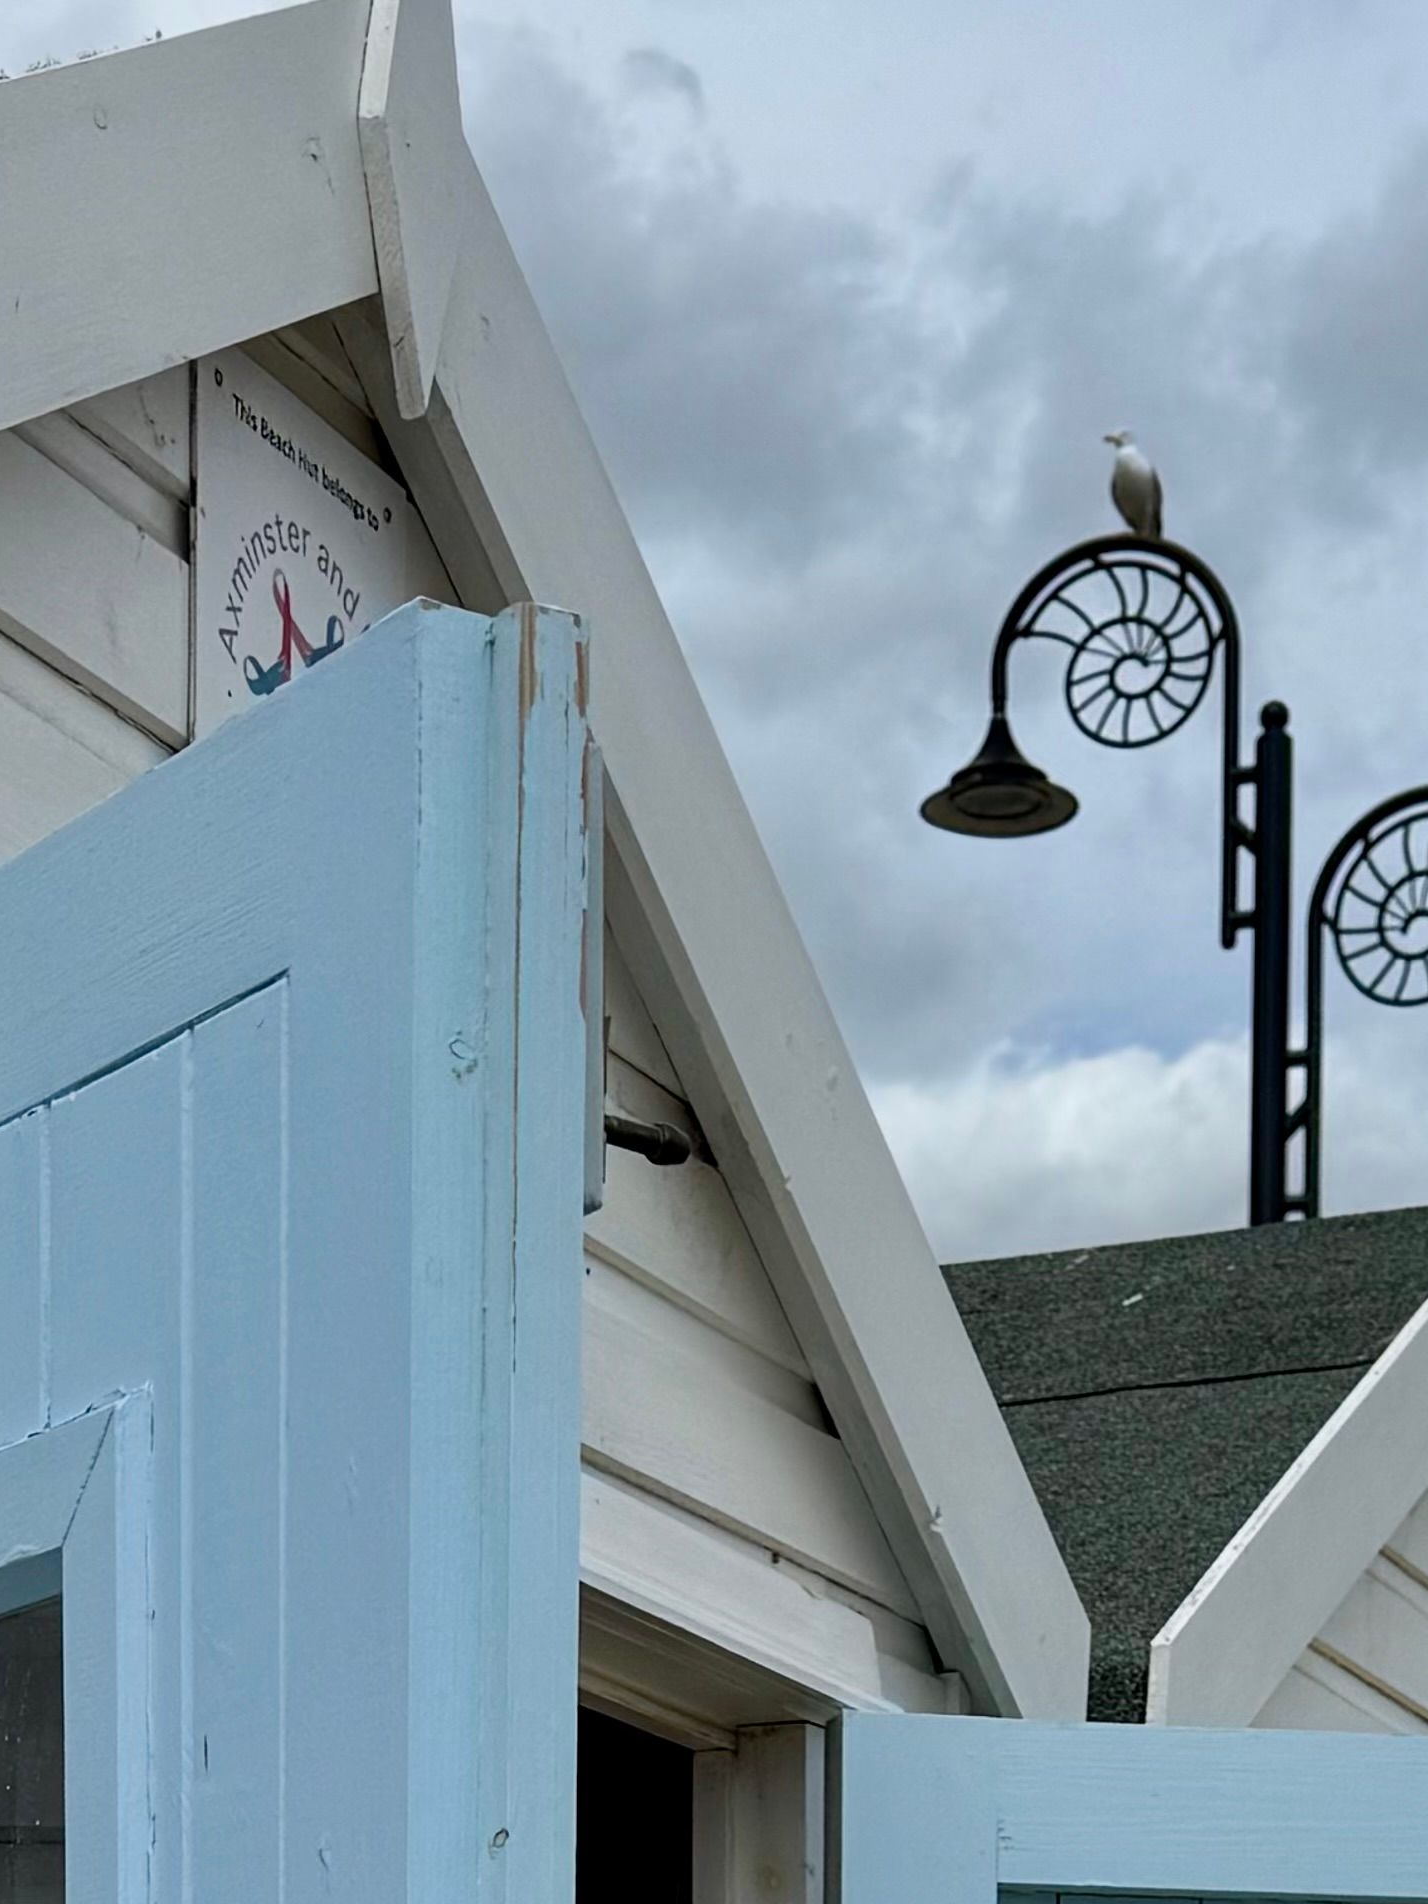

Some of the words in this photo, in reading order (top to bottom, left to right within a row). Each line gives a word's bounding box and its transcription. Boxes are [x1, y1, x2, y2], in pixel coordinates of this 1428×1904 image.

[232, 393, 257, 431] This
[261, 417, 296, 464] Beach
[298, 448, 319, 483] Hut
[322, 465, 365, 520] belongs
[367, 508, 379, 531] to
[218, 513, 311, 664] Axminster
[317, 544, 360, 622] and
